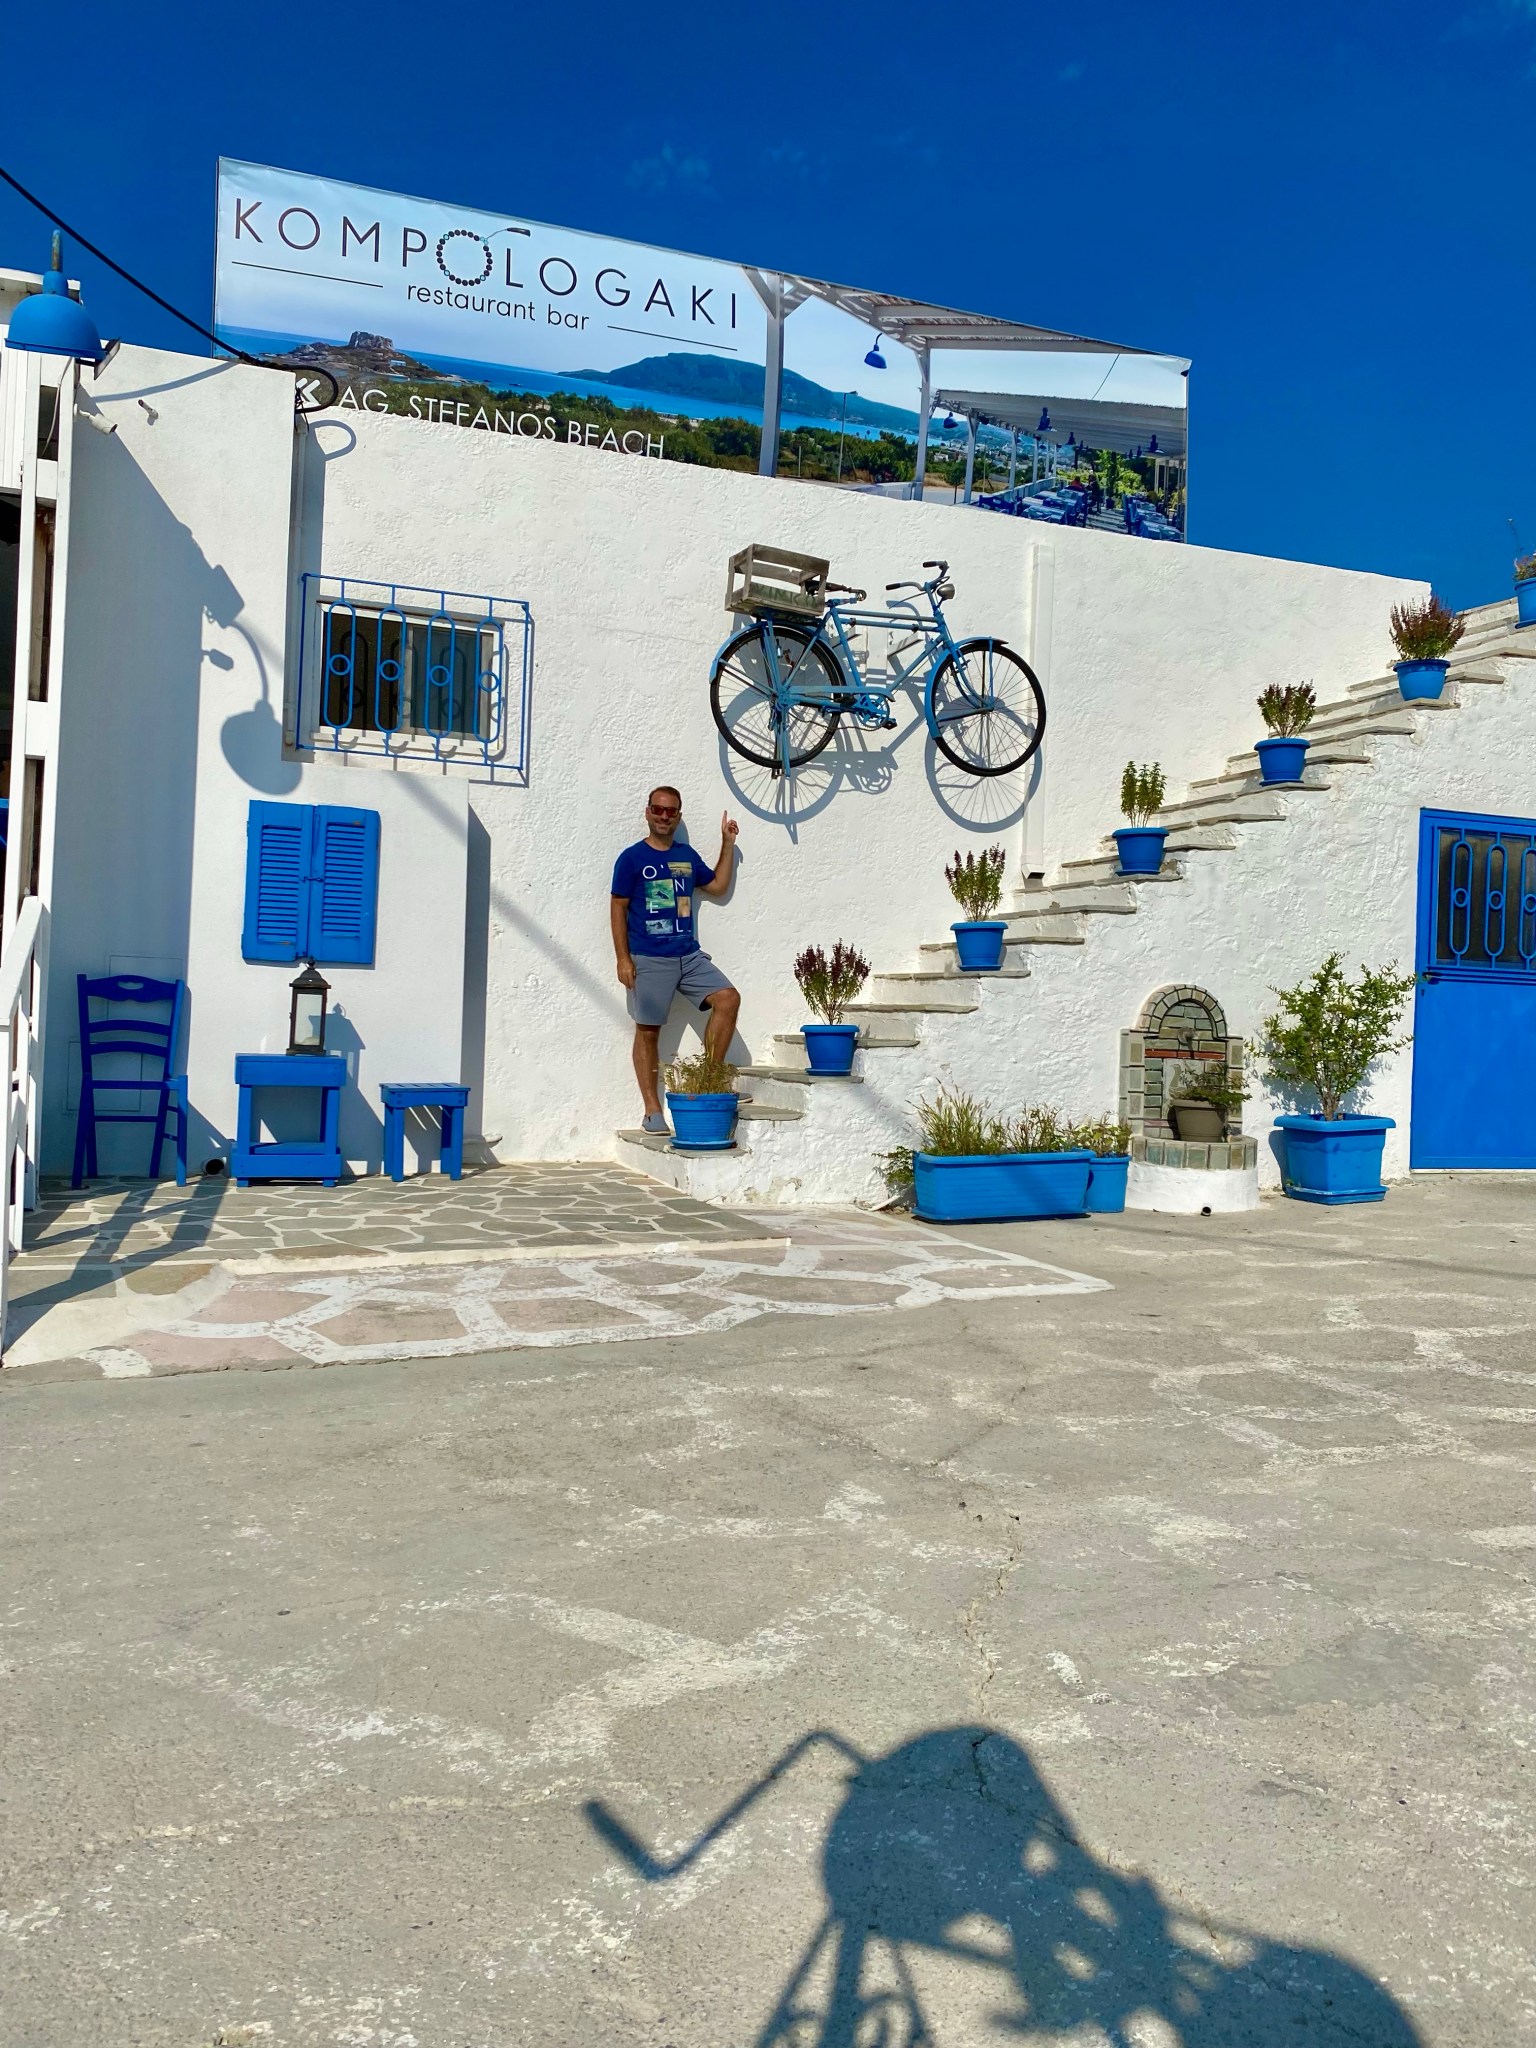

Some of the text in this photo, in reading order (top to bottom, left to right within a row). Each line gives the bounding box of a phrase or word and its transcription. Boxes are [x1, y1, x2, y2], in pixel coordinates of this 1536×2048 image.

[234, 197, 736, 329] KOMPOLOGAKI
[407, 284, 590, 331] restaurant bar
[408, 395, 557, 442] STEFANOS
[562, 420, 665, 460] BEACH
